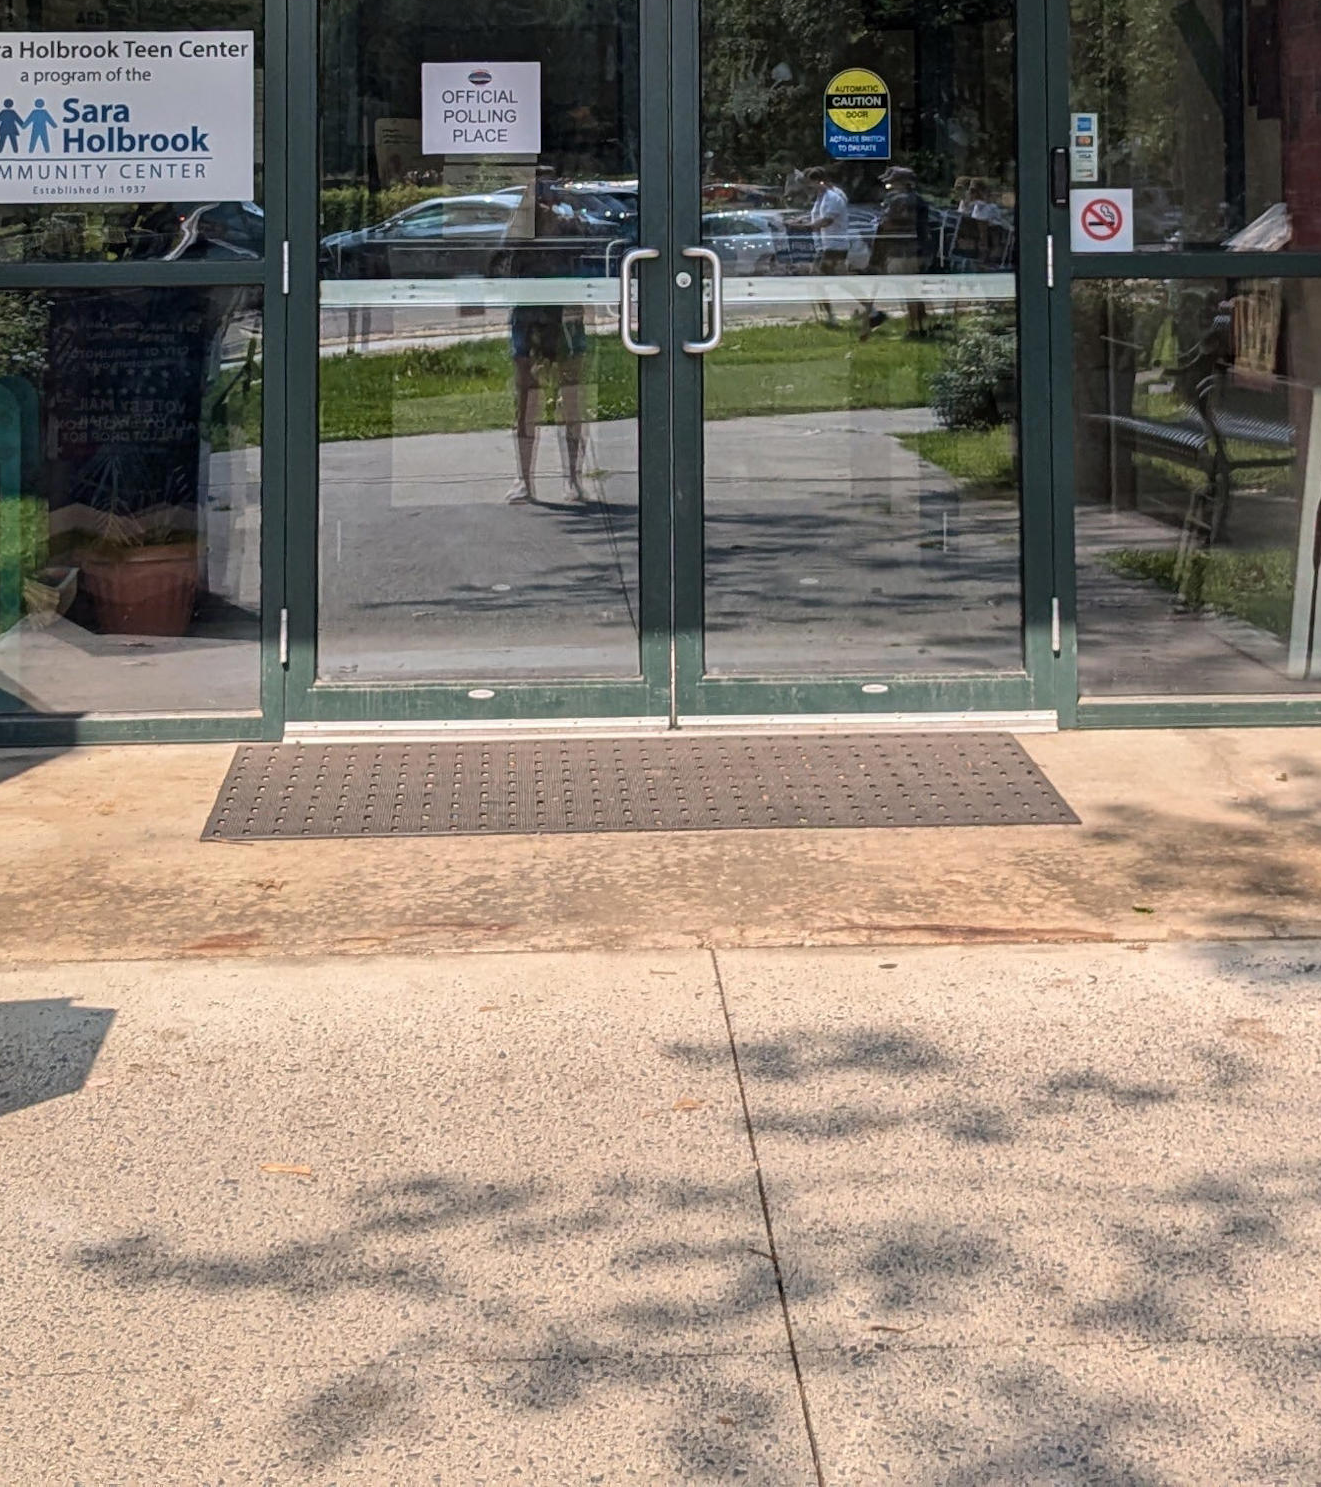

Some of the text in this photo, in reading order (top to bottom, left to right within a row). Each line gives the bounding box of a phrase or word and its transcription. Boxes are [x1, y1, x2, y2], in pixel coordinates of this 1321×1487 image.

[19, 40, 120, 59] Holbrook
[123, 40, 173, 58] Teen
[179, 40, 249, 58] Center
[20, 68, 152, 86] a program of the
[834, 85, 879, 93] AUTOMATIC
[441, 89, 519, 105] OFFICIAL
[831, 96, 882, 107] CAUTION
[62, 97, 131, 124] Sara
[443, 109, 517, 124] POLLING
[845, 110, 869, 119] DOOR
[62, 125, 210, 154] Holbrook
[452, 128, 509, 143] PLACE
[119, 162, 207, 180] CENTER
[32, 185, 147, 195] Established in 1937
